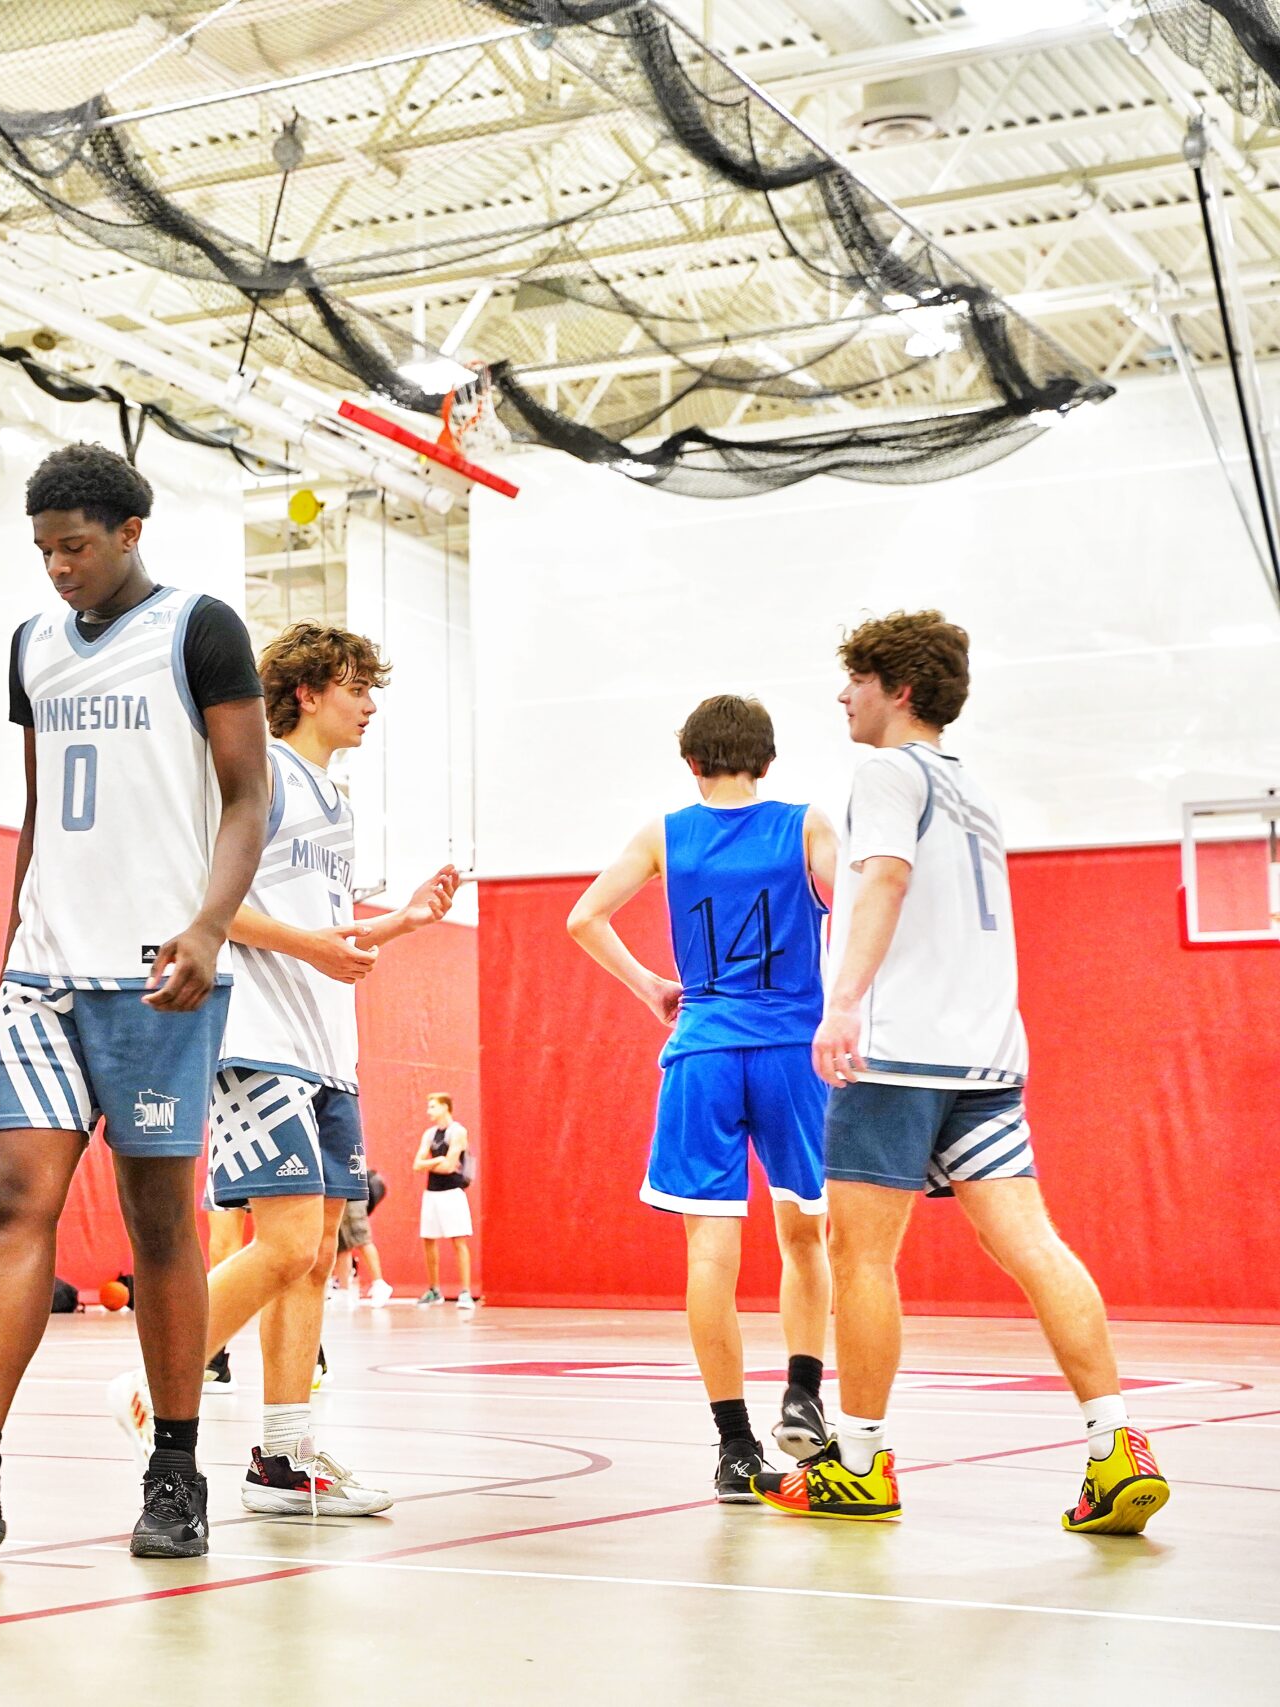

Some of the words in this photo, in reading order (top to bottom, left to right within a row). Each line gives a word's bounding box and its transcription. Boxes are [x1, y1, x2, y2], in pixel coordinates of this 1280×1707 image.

[62, 744, 98, 832] 0
[291, 838, 353, 894] MINNESO
[687, 888, 784, 996] 14
[276, 1166, 309, 1176] adidas
